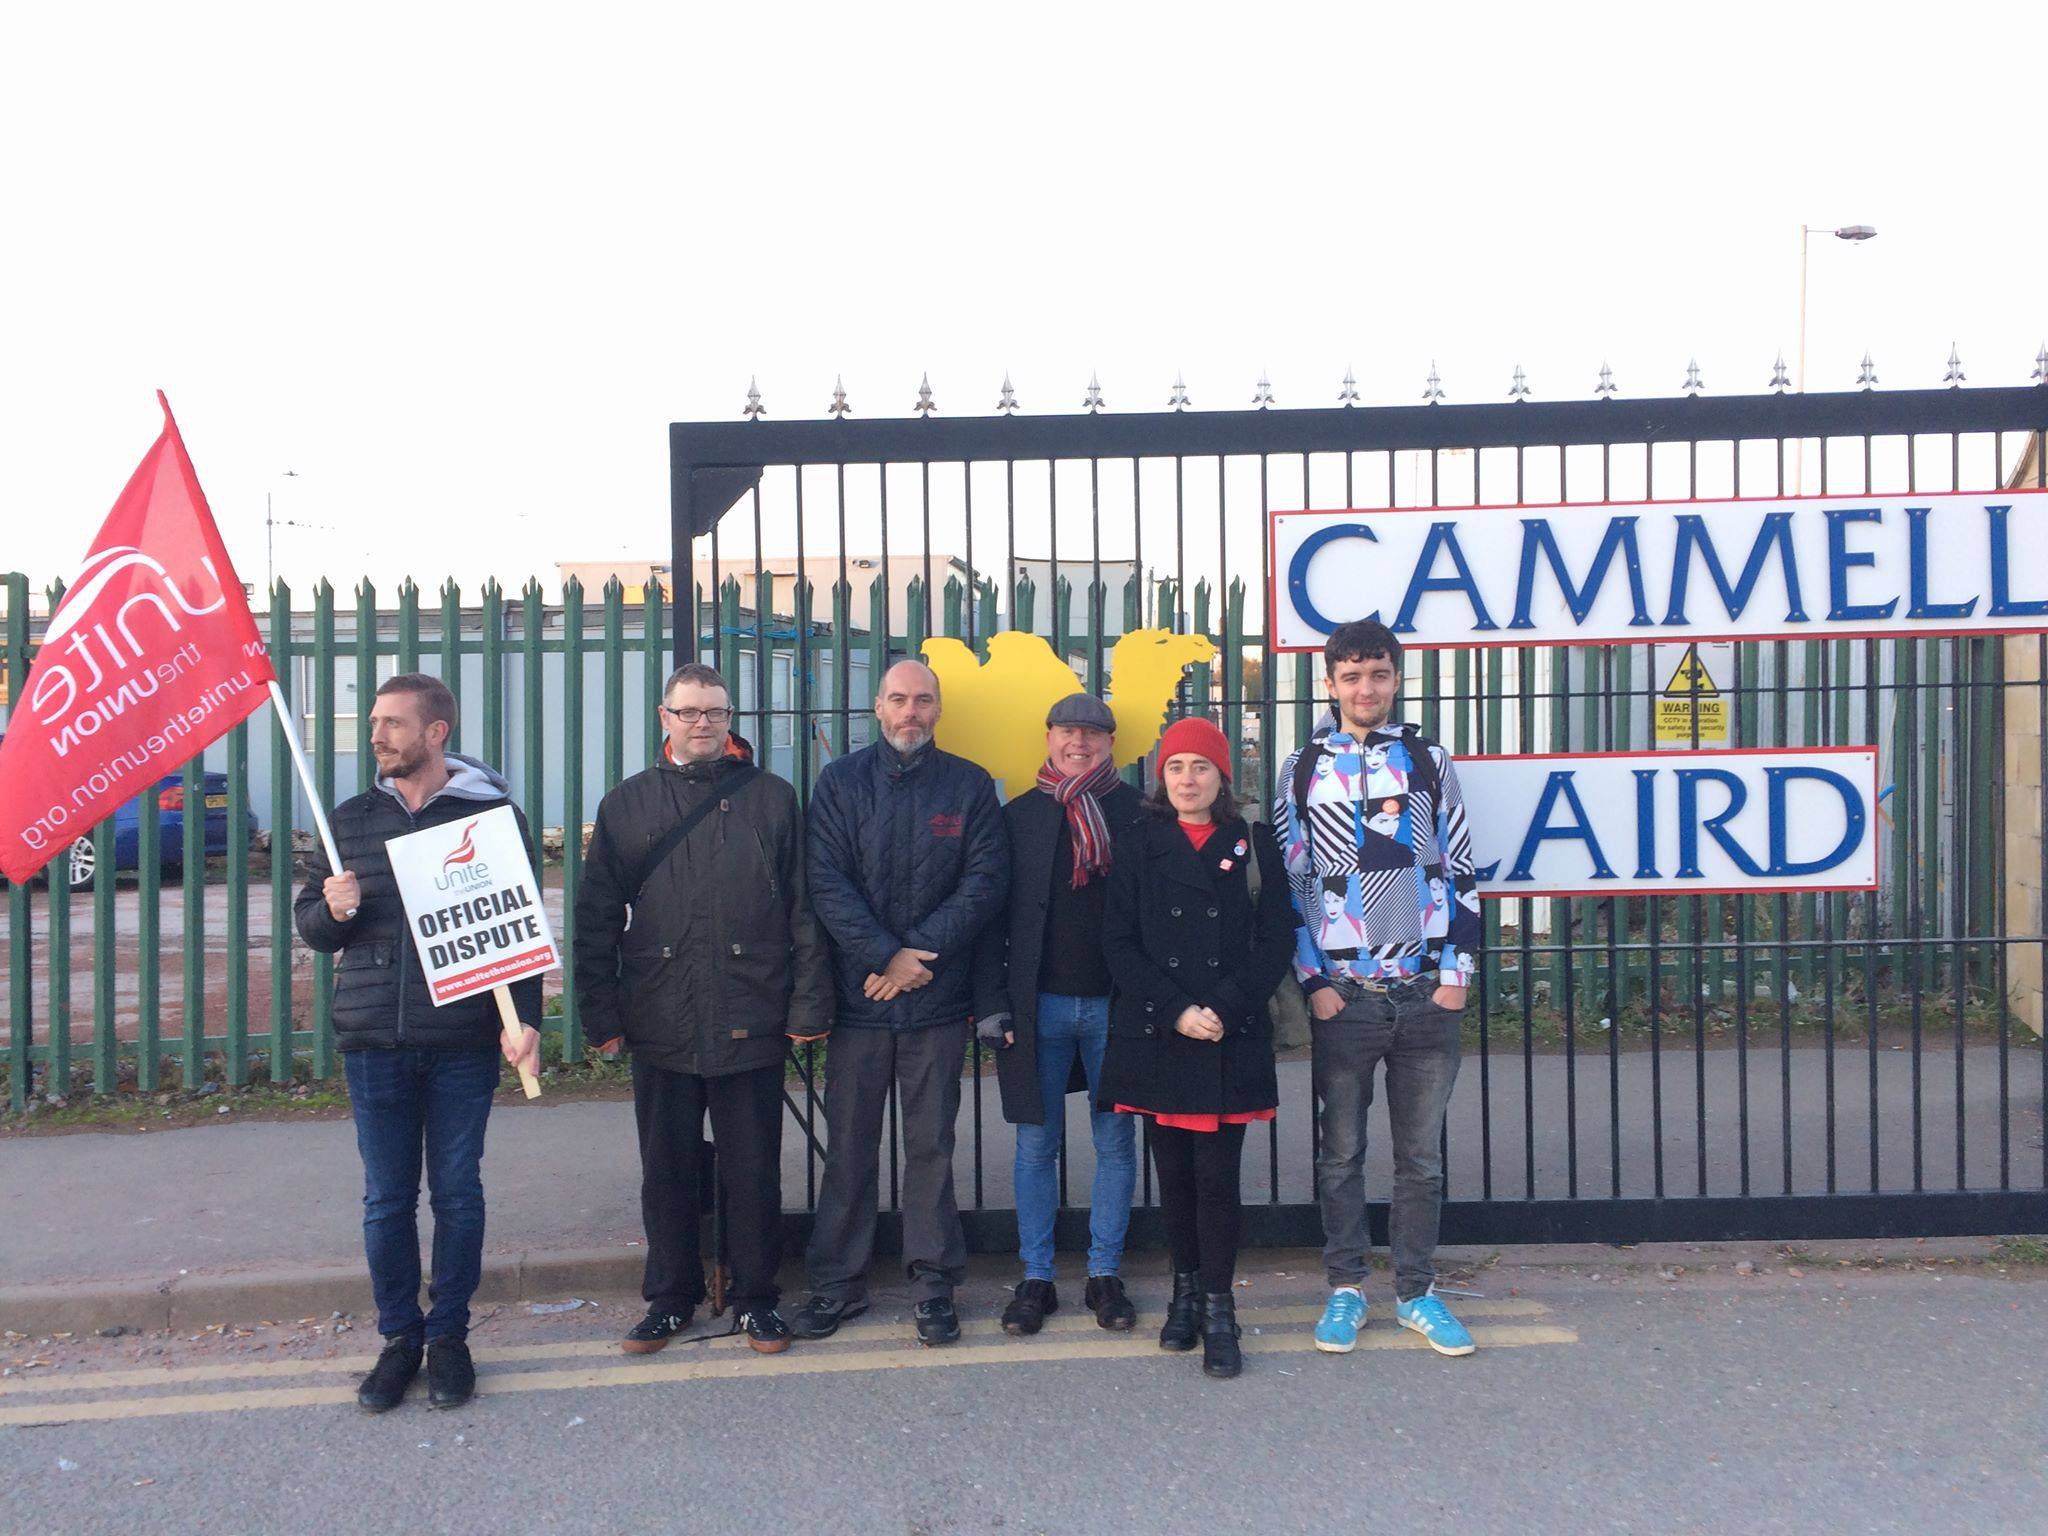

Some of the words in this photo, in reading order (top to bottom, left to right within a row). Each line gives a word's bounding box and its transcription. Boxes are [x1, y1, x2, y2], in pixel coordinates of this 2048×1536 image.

[1288, 505, 2048, 636] CAMMELL
[1663, 703, 1720, 713] WARING
[434, 862, 489, 891] unite
[418, 885, 532, 938] OFFICIAL
[428, 915, 541, 970] DISPUTE
[437, 952, 551, 993] www.unitetheunion.org
